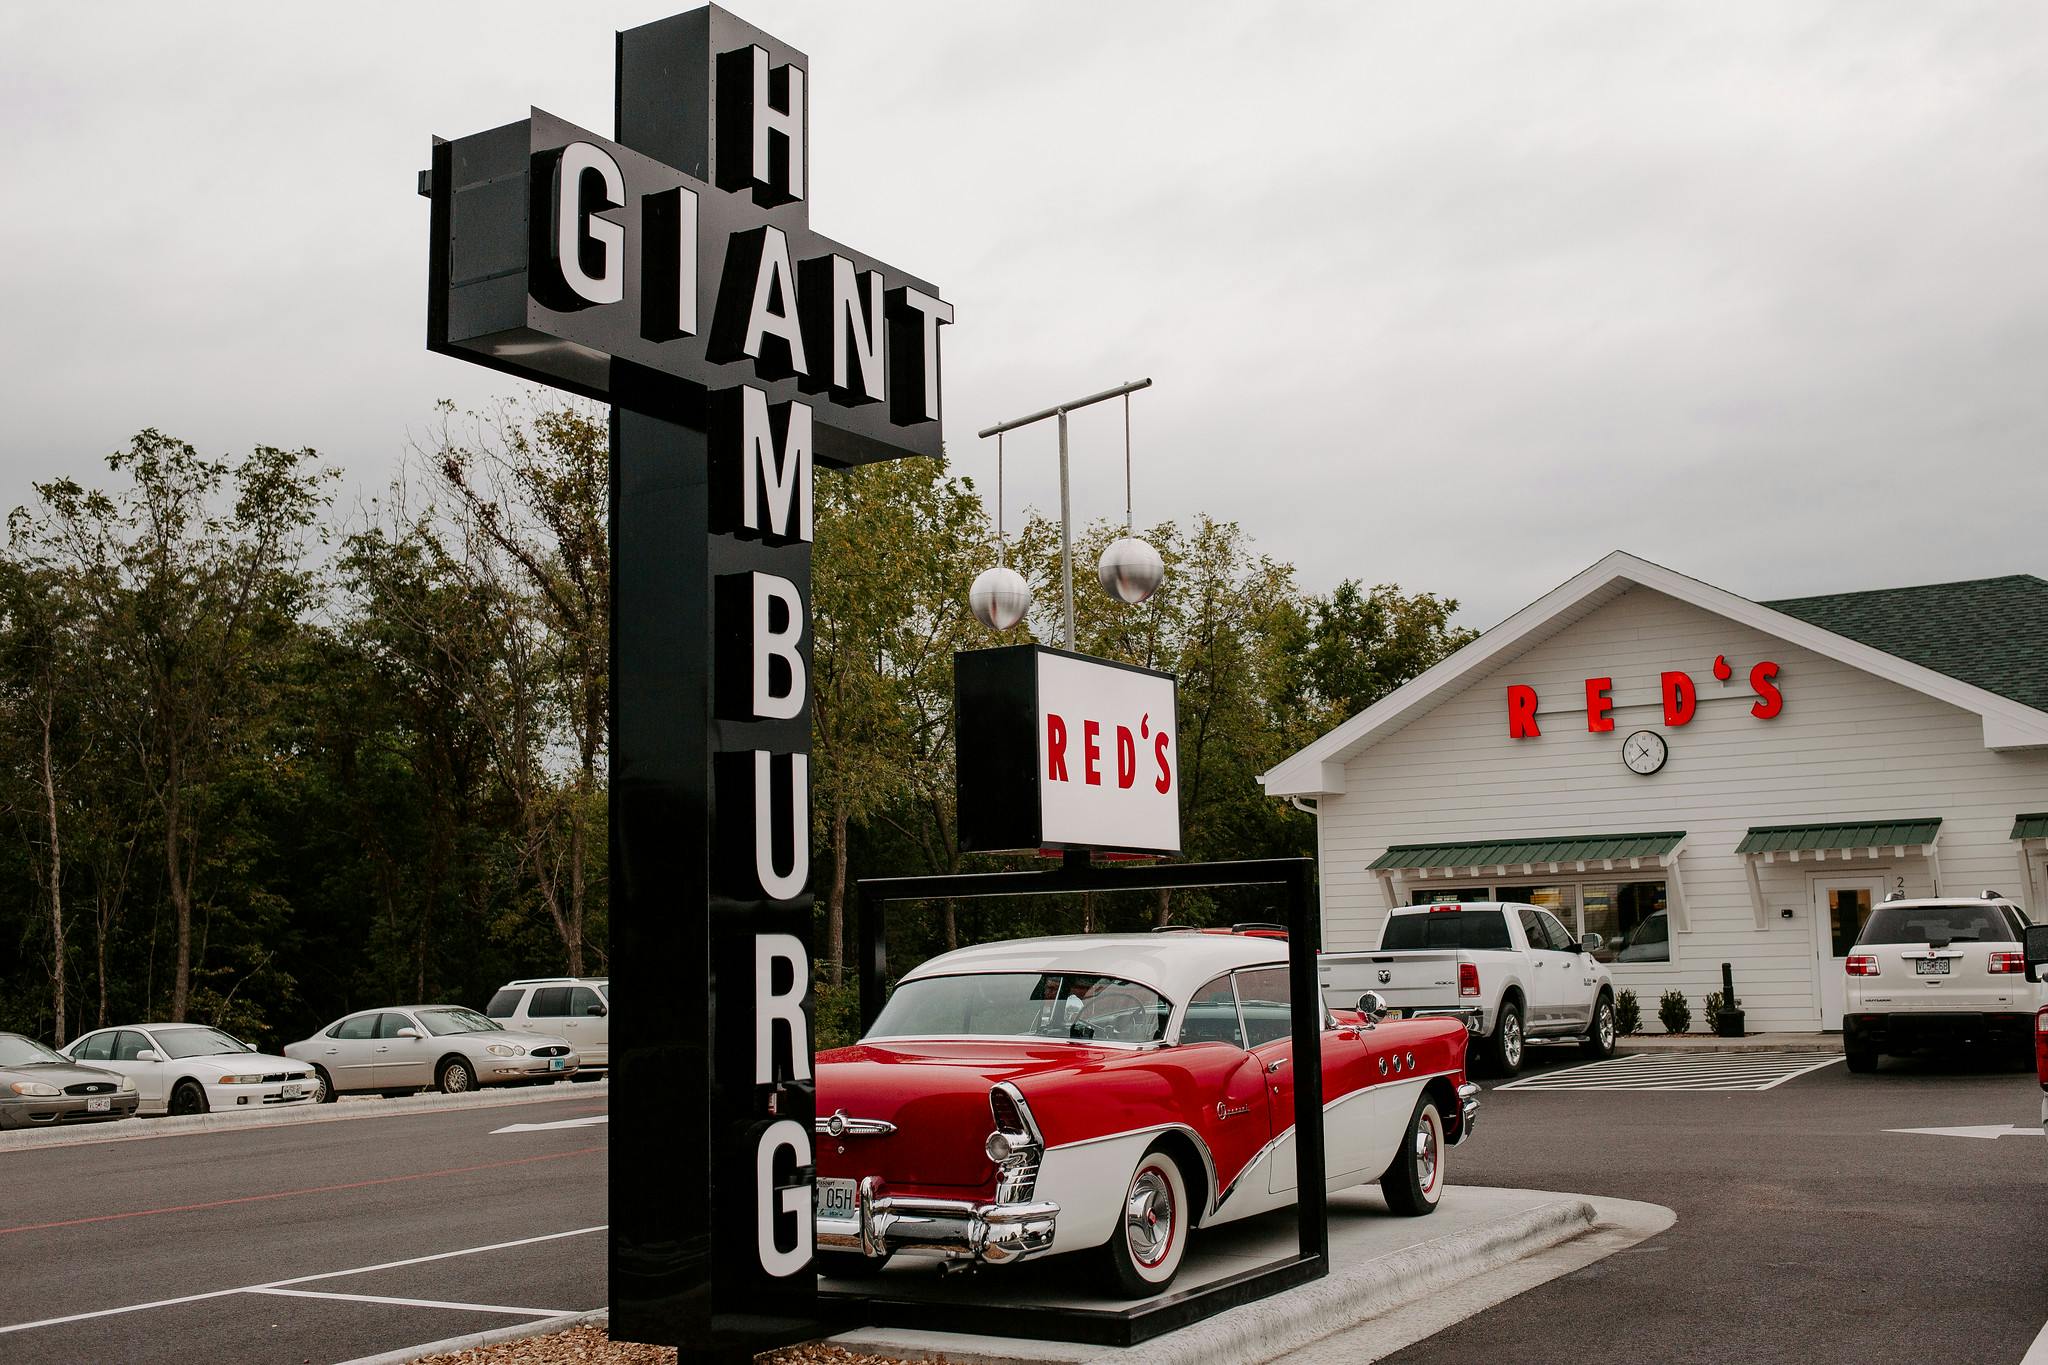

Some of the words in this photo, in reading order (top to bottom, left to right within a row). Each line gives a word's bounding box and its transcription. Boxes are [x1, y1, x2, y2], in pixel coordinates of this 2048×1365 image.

[559, 141, 954, 422] GIANT
[743, 44, 813, 1277] HAMBURG
[1507, 655, 1783, 739] RED'S
[1047, 712, 1171, 795] RED'S
